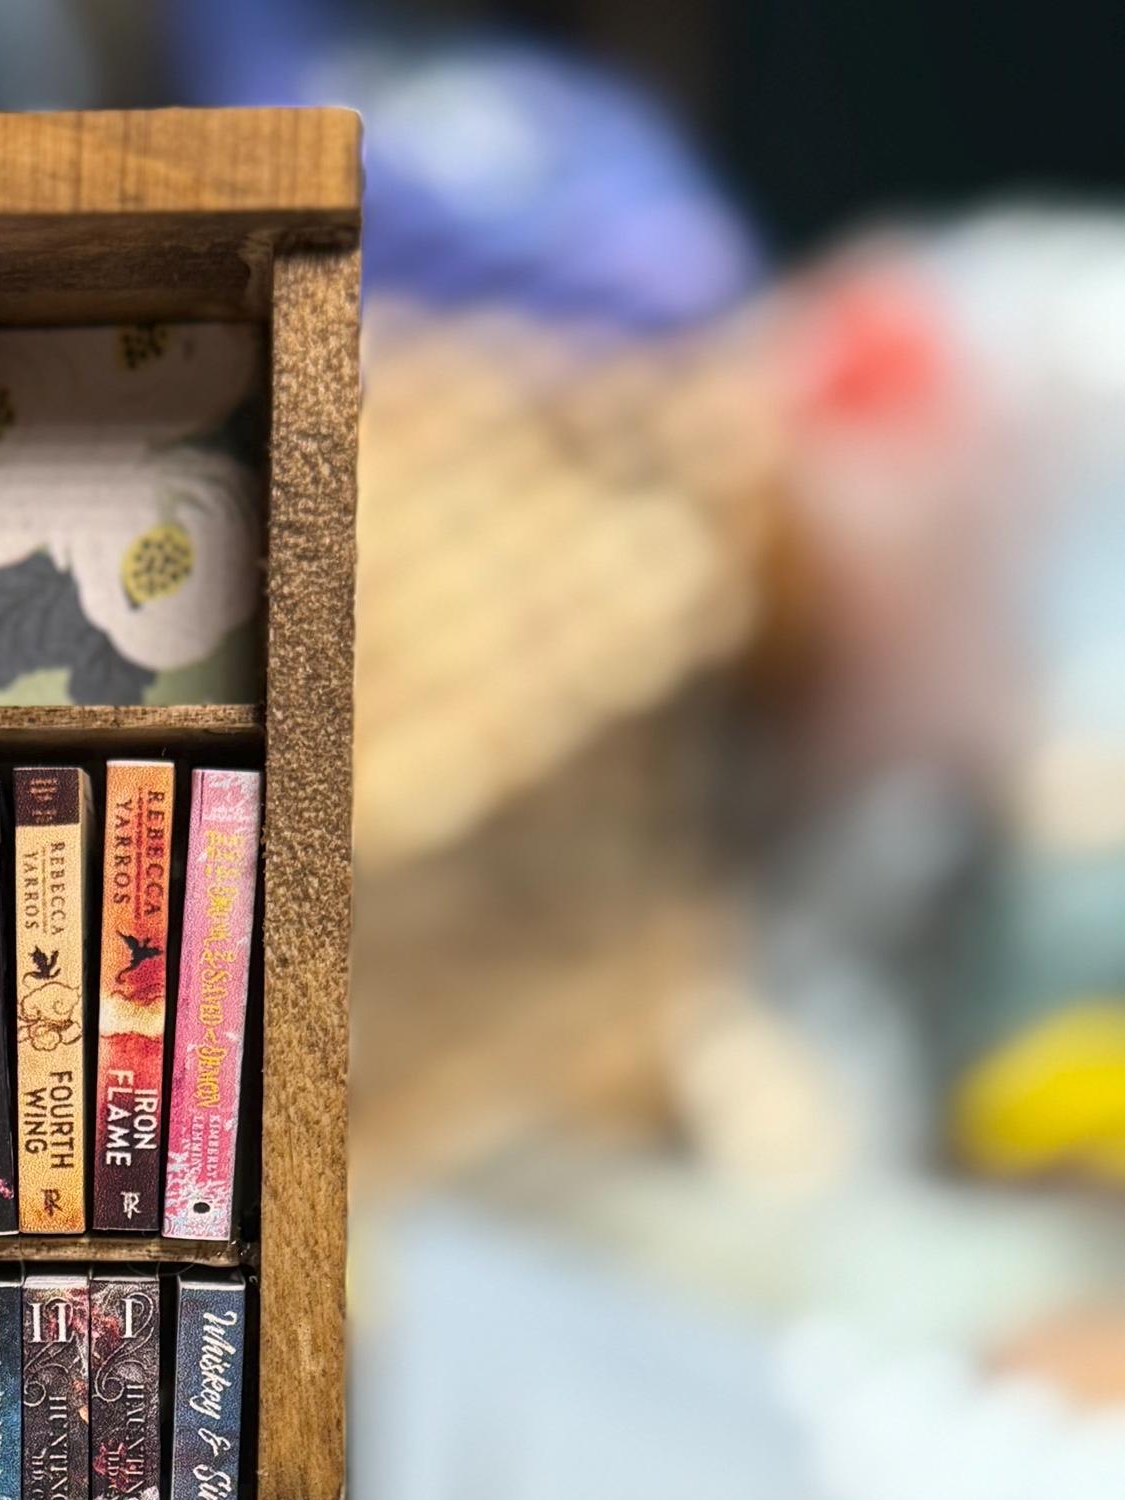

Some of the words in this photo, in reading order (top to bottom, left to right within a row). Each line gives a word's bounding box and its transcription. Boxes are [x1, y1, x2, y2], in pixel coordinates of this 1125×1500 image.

[24, 851, 40, 930] YARROS
[50, 841, 66, 936] REBECCA
[113, 799, 133, 905] YARROS
[144, 790, 166, 916] REBECCA
[24, 1086, 48, 1155] WING
[50, 1070, 75, 1170] FOURTH
[105, 1069, 135, 1167] FLAME
[133, 1088, 158, 1151] IRON
[189, 1310, 237, 1420] Whiskey
[197, 1427, 231, 1458] &
